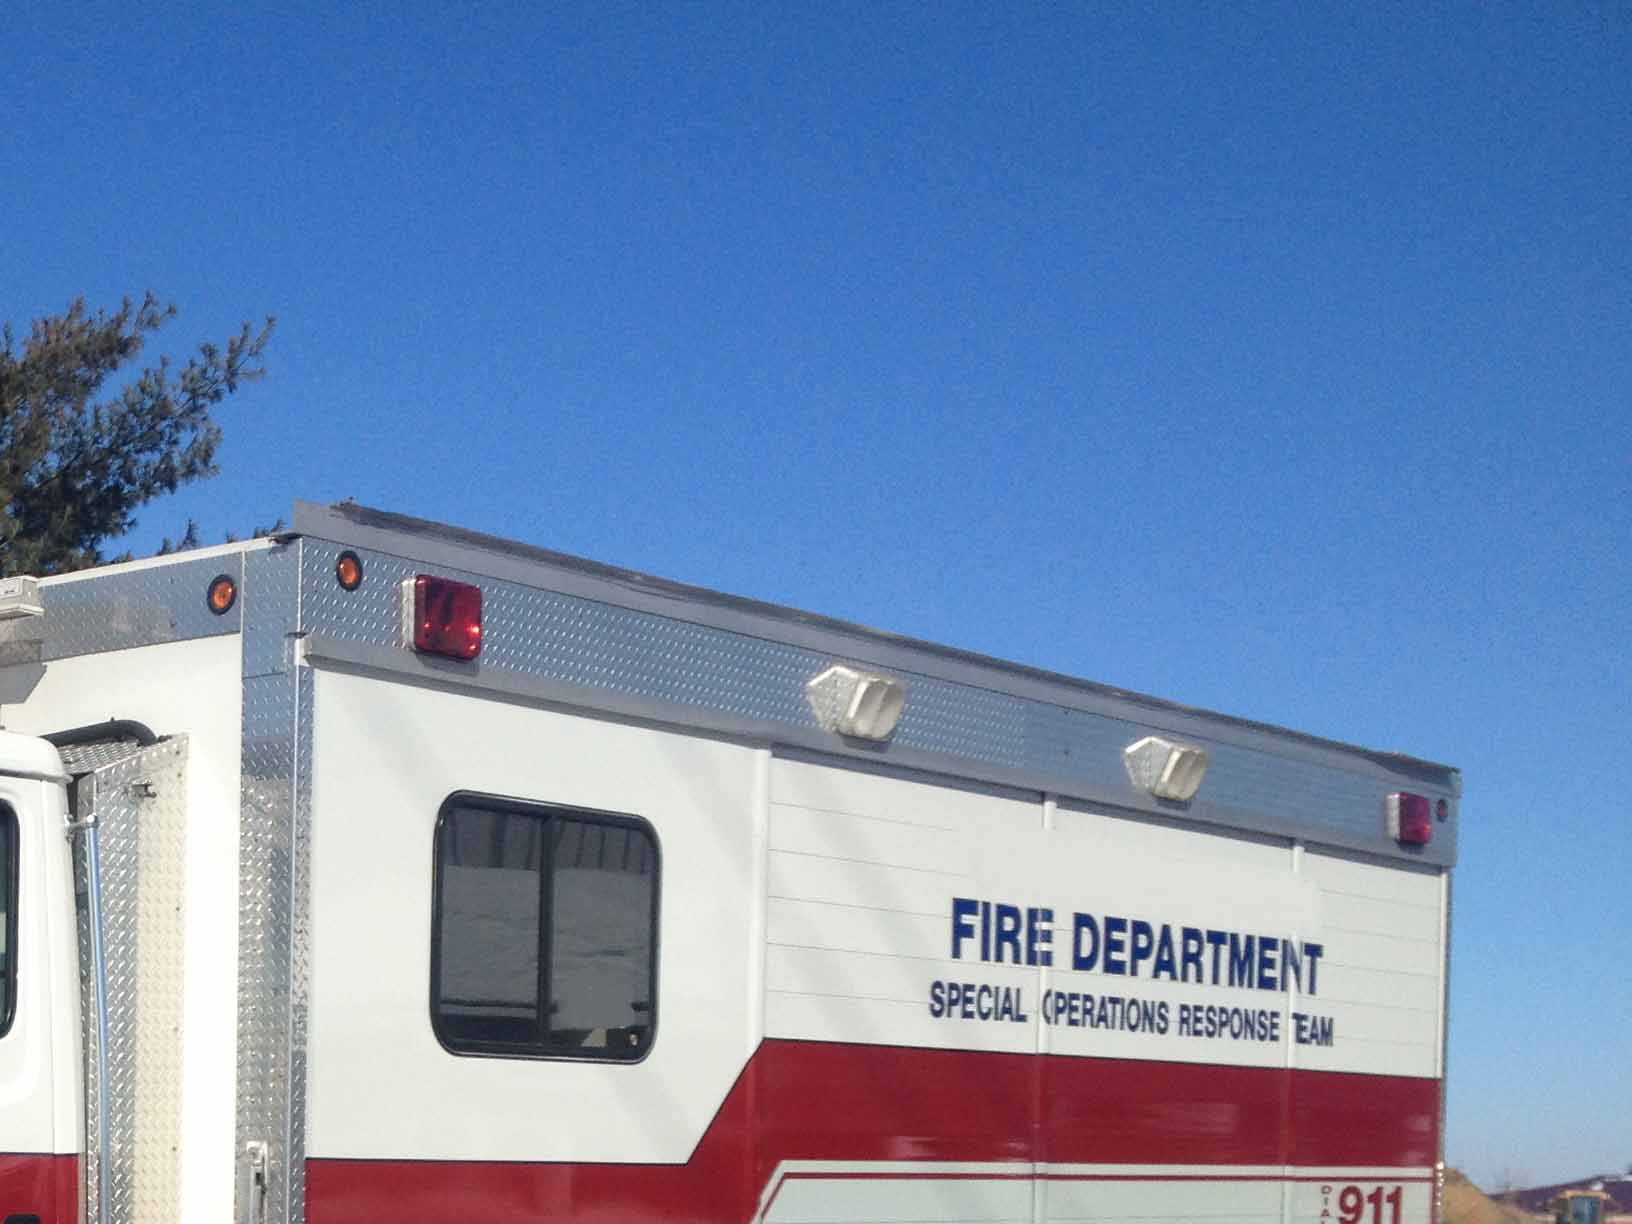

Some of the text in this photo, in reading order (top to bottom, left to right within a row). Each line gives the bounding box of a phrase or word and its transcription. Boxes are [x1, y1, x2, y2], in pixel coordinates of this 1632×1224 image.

[951, 897, 1324, 995] FIRE DEPARTMENT
[929, 980, 1028, 1023] SPECIAL
[1179, 1003, 1280, 1042] RESPONSE
[1292, 1012, 1334, 1047] TEAM
